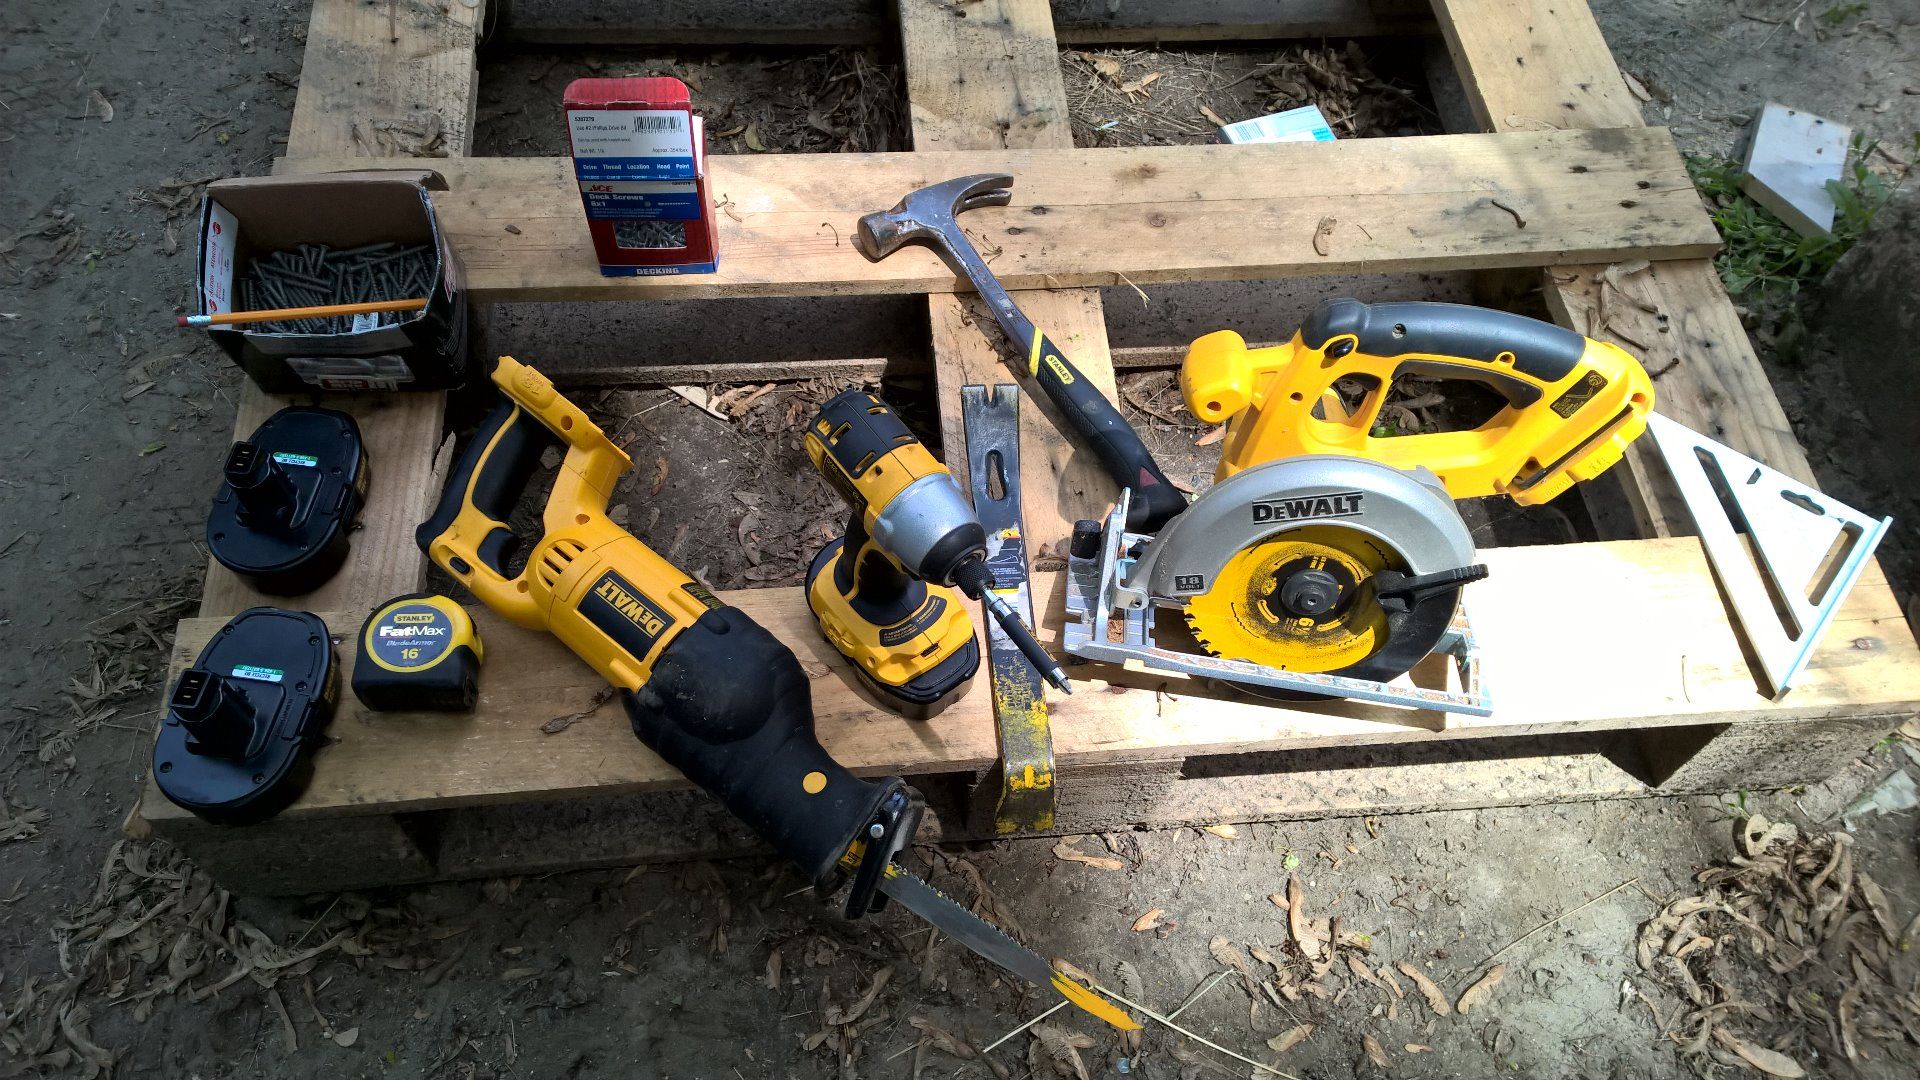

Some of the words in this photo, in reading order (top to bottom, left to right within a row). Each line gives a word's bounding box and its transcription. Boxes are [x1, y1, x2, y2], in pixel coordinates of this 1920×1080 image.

[603, 163, 622, 171] Thread
[588, 184, 614, 193] ACE
[589, 193, 611, 201] Deck
[636, 267, 680, 276] DECKING
[1048, 356, 1072, 382] STANLEY
[1252, 494, 1364, 522] DEWALT
[1179, 576, 1201, 585] 18
[594, 580, 665, 638] DEWALT
[379, 625, 446, 637] FatMax
[386, 639, 436, 647] BladeArmor
